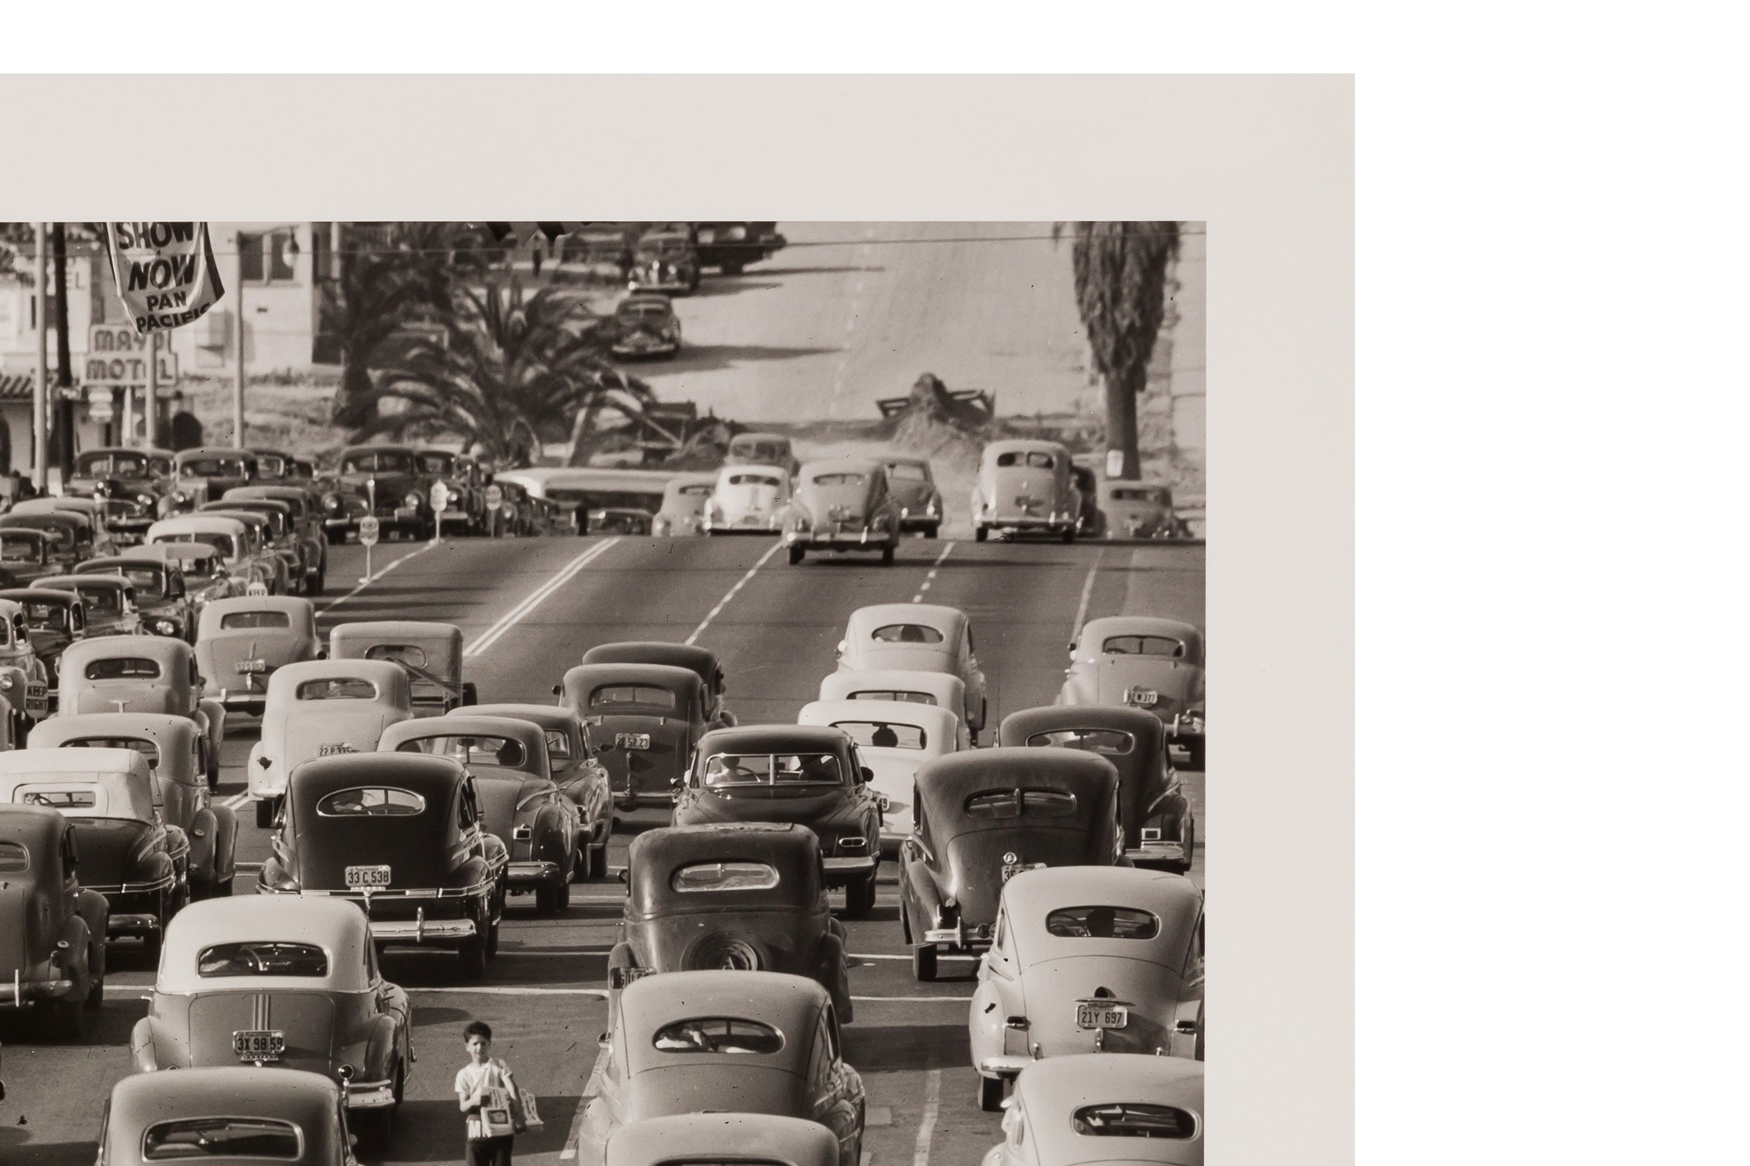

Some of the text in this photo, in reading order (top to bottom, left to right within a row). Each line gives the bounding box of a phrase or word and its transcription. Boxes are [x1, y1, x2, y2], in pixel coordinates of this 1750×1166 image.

[116, 222, 194, 250] SHOW
[128, 255, 196, 292] NOW
[146, 290, 187, 312] PAN
[86, 359, 173, 380] MOTL
[26, 685, 47, 697] KEEP
[348, 870, 389, 884] 33 C 538
[1104, 1011, 1123, 1024] 697
[253, 1037, 267, 1050] 98
[270, 1037, 284, 1051] 59
